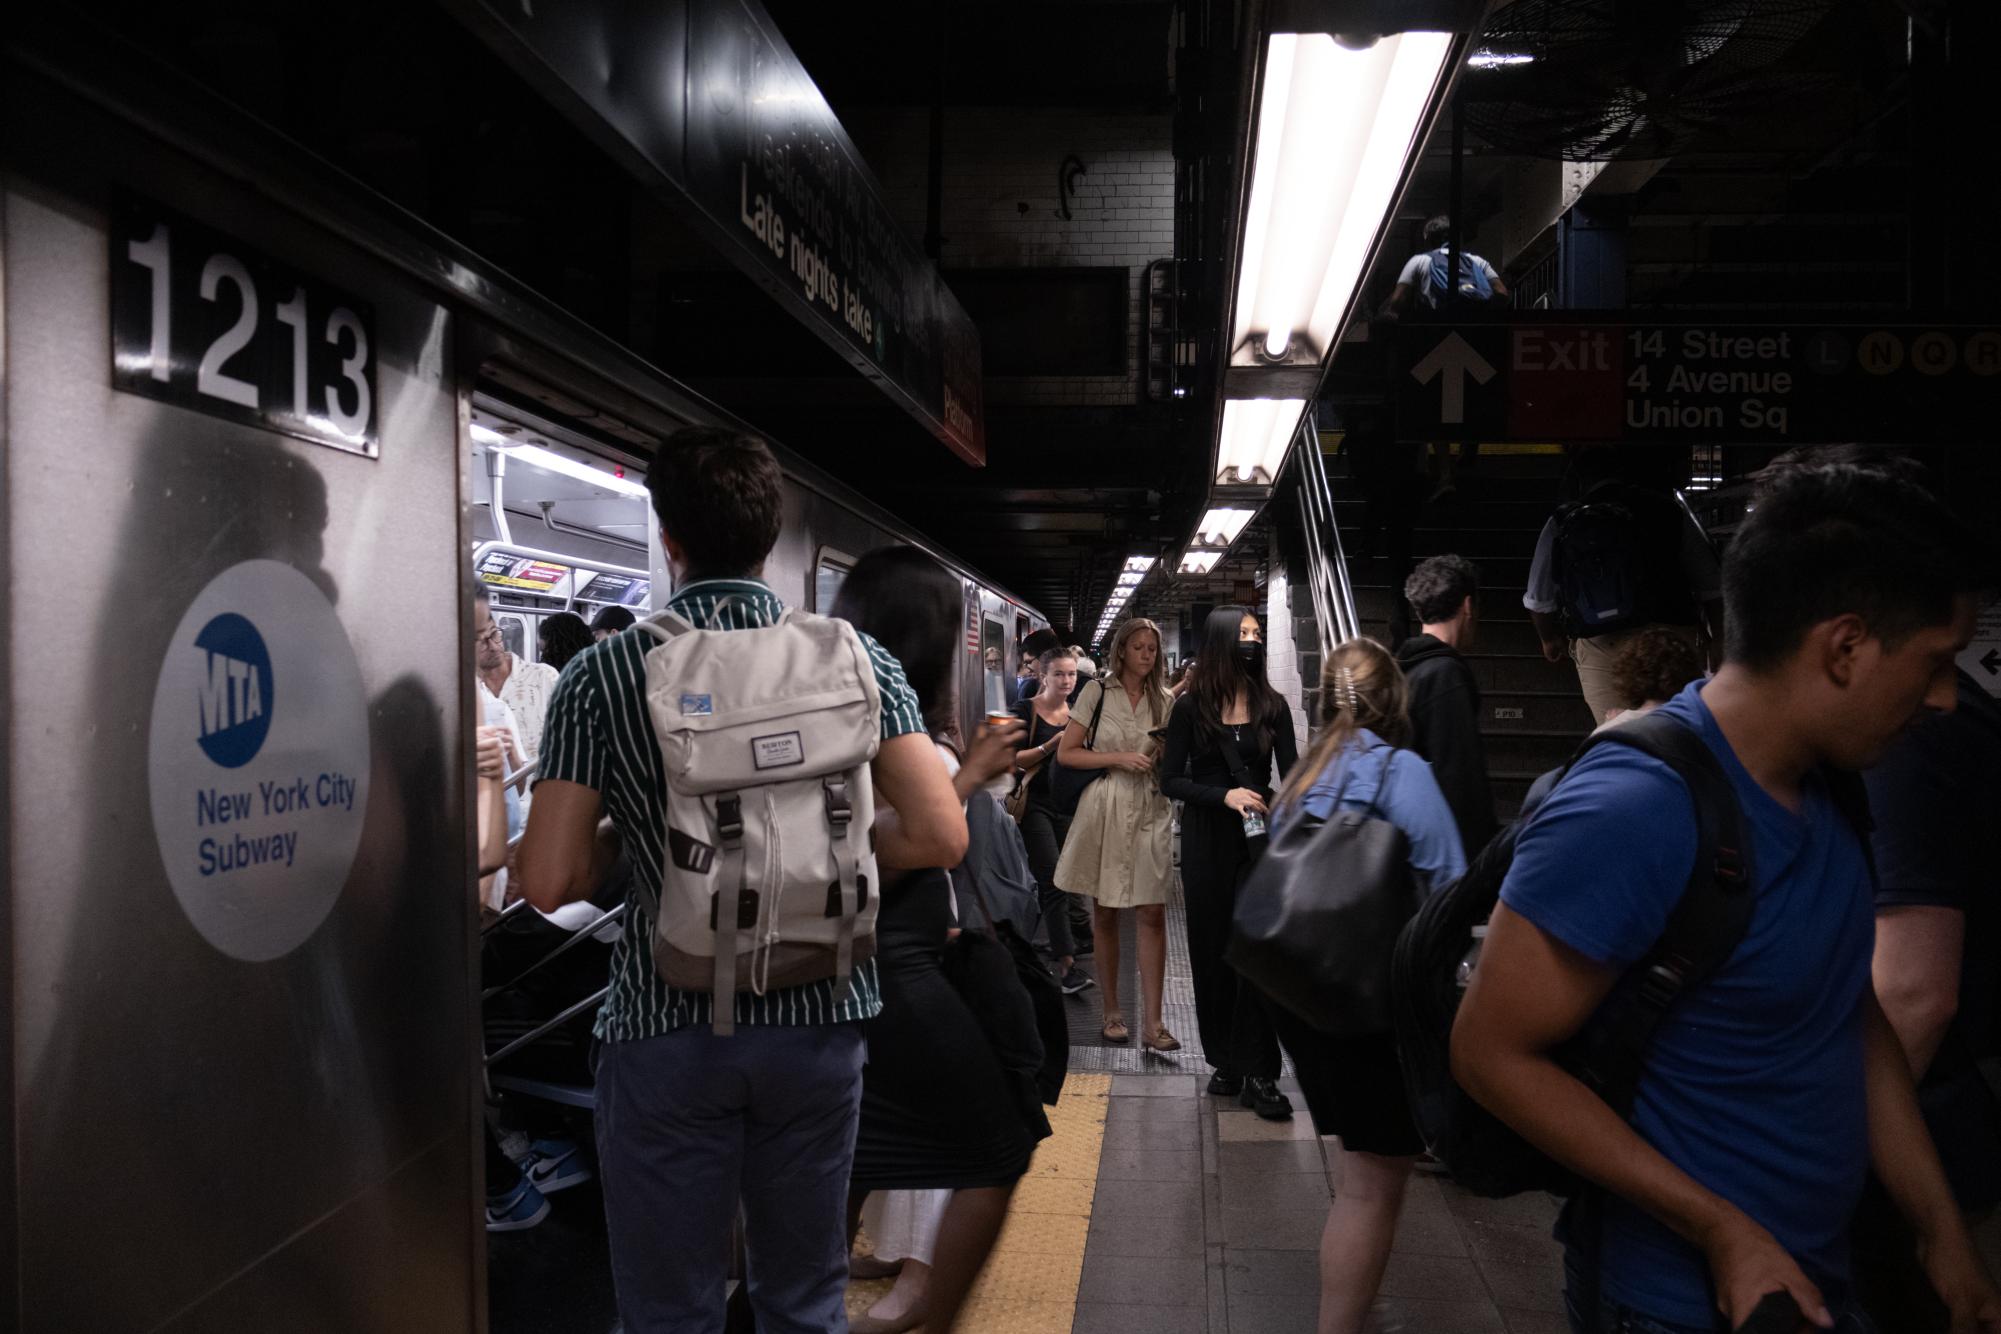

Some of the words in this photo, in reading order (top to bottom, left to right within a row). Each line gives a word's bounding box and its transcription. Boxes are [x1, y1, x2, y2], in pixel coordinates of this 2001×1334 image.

[740, 161, 784, 259] Late
[790, 227, 838, 312] nights
[843, 276, 872, 344] take
[128, 222, 371, 437] 1213
[1512, 329, 1611, 371] Exit
[1627, 329, 1667, 359] 14
[1681, 329, 1791, 359] Street
[1626, 364, 1650, 393] 4
[1665, 364, 1792, 394] Avenue
[1627, 399, 1724, 429] Union
[1739, 399, 1789, 434] Sq
[199, 647, 262, 737] MTA
[198, 788, 251, 826] New
[259, 777, 310, 815] York
[315, 773, 356, 811] City
[199, 831, 297, 876] Subway
